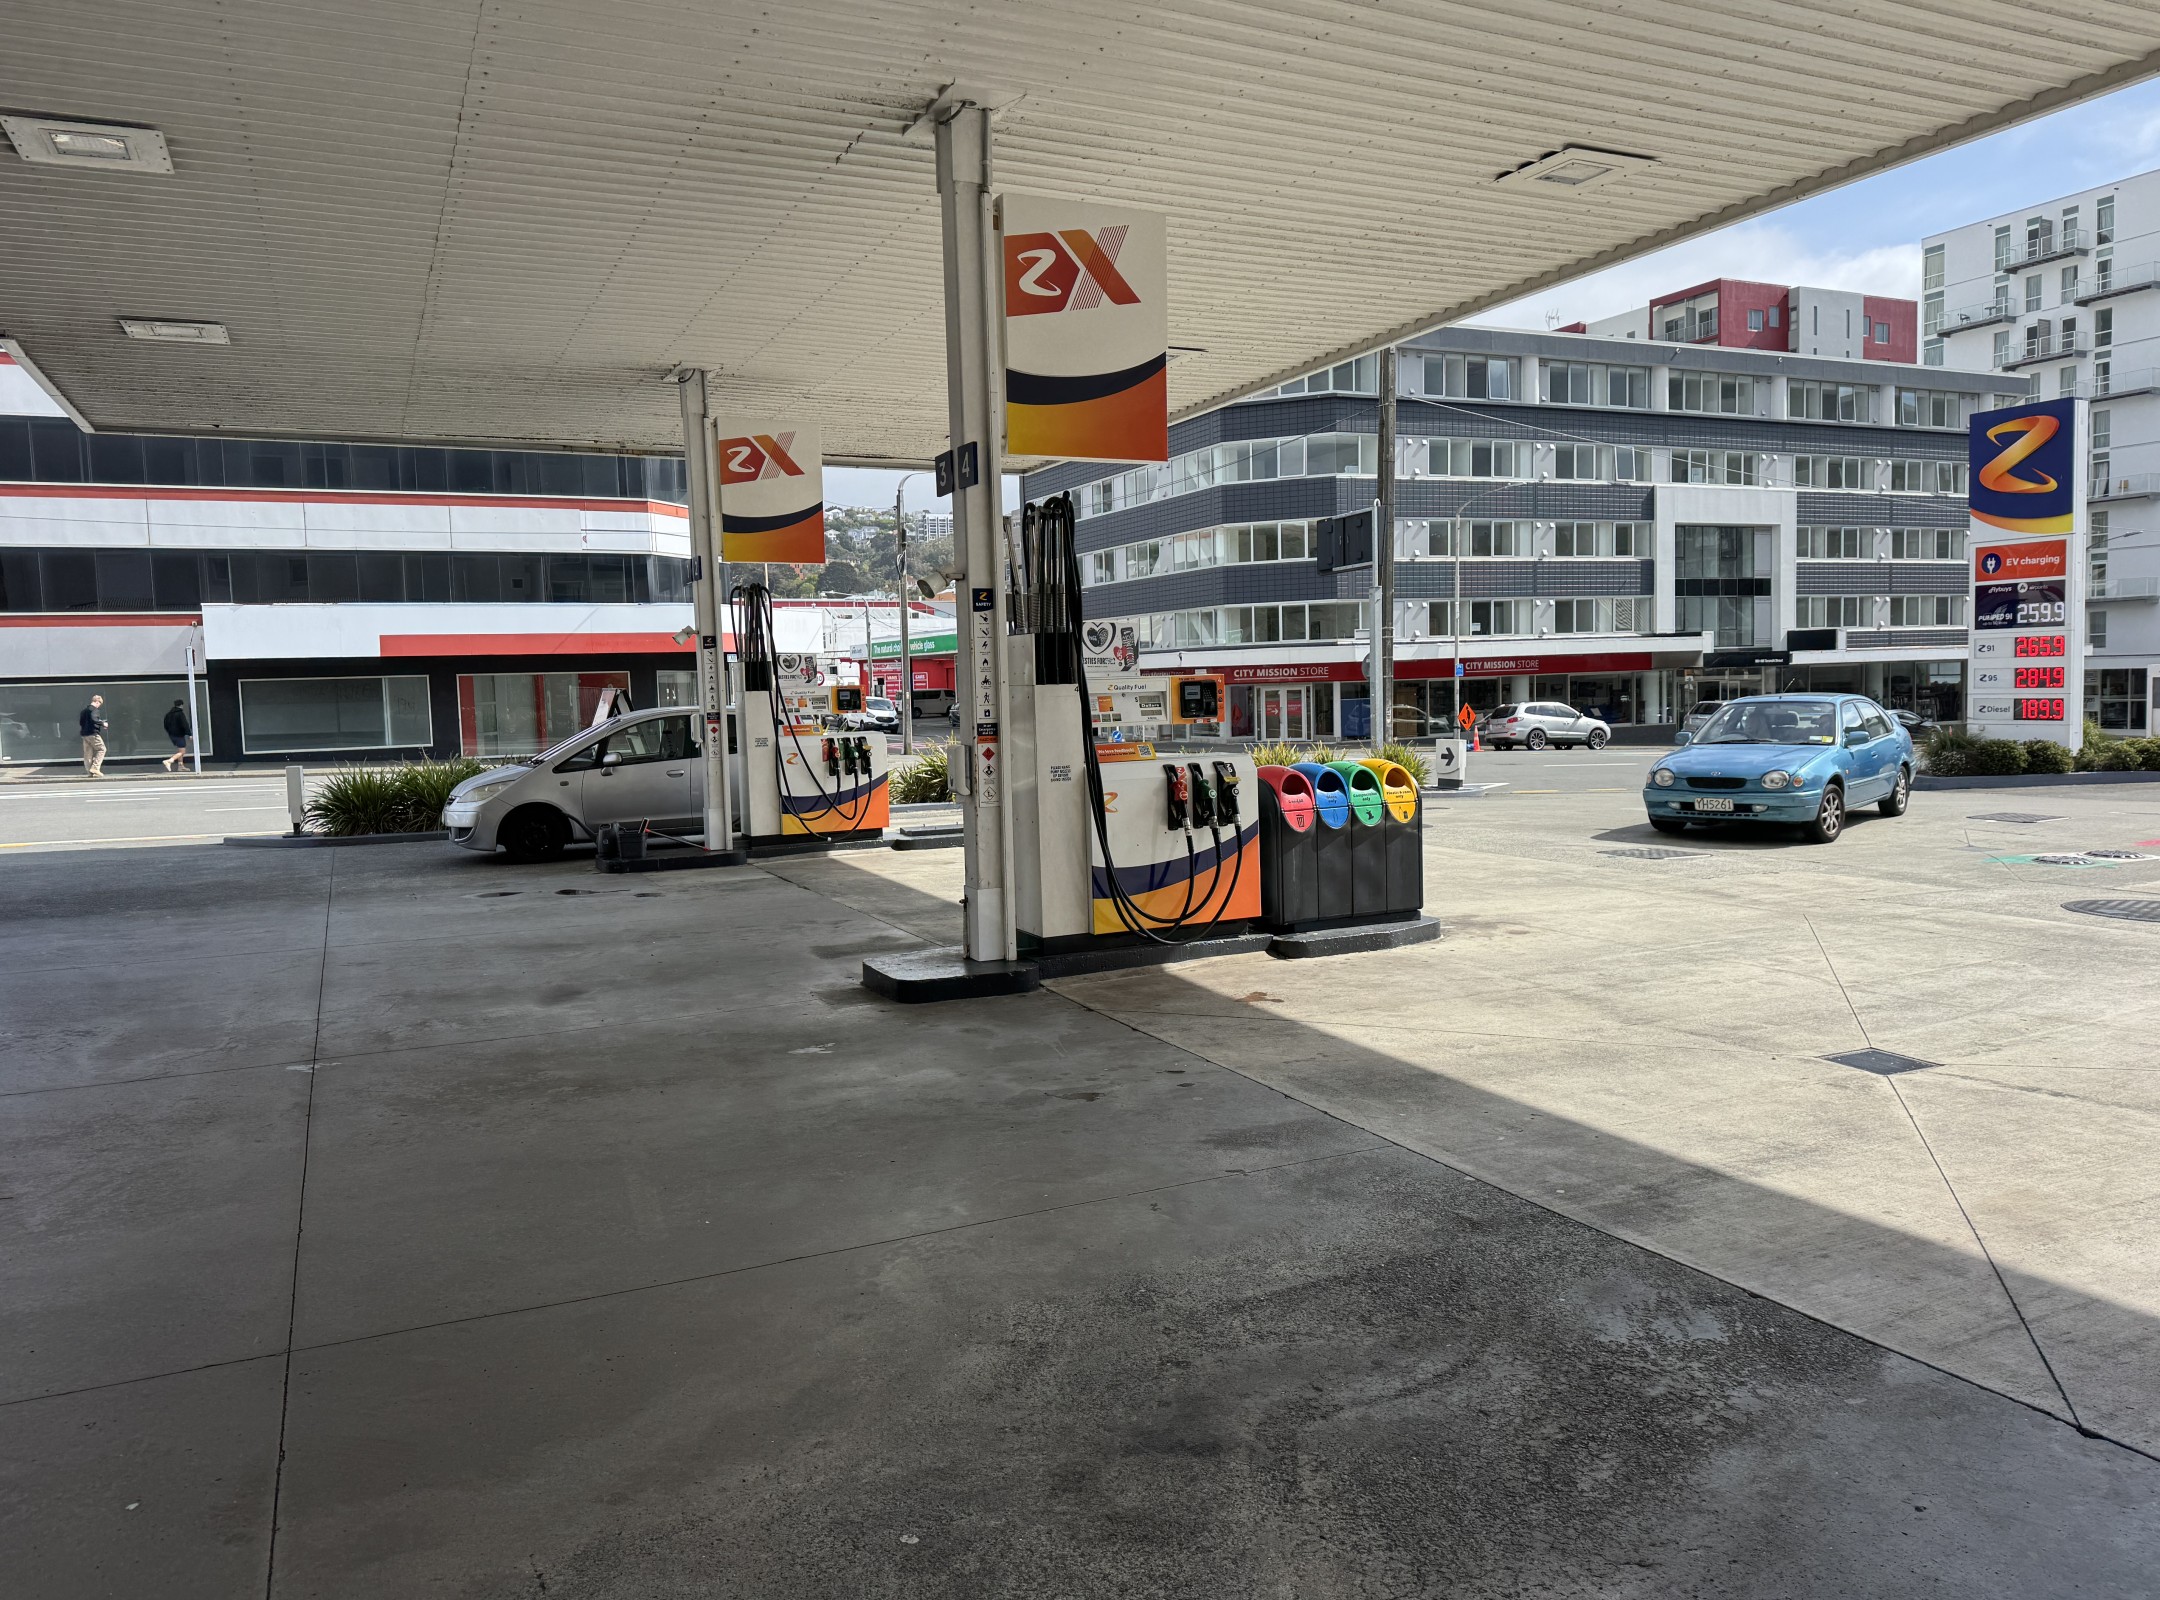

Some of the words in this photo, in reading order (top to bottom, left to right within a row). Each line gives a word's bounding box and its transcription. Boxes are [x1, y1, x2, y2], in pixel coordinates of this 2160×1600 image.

[1979, 415, 2059, 494] Z
[961, 451, 970, 478] 4
[939, 460, 947, 487] 3
[2006, 558, 2019, 566] EV
[2020, 554, 2060, 566] charging
[1978, 613, 2004, 622] PUMPED
[2016, 601, 2065, 624] 259.9
[873, 645, 881, 654] The
[880, 643, 892, 653] natural
[910, 641, 924, 651] vehicle
[923, 640, 936, 652] glass
[1986, 644, 1995, 652] 91
[2016, 635, 2065, 658] 265.9
[1465, 661, 1482, 670] CITY
[1483, 660, 1516, 669] MISSION
[1517, 659, 1540, 668] STORE
[1233, 669, 1255, 678] CITY
[1256, 667, 1298, 677] MISSION
[1299, 666, 1329, 676] STORE
[1988, 674, 1998, 682] 95
[2016, 667, 2064, 688] 284.9
[1986, 705, 2011, 713] Diesel
[2021, 699, 2064, 719] 189.9
[1696, 799, 1732, 810] YH5261
